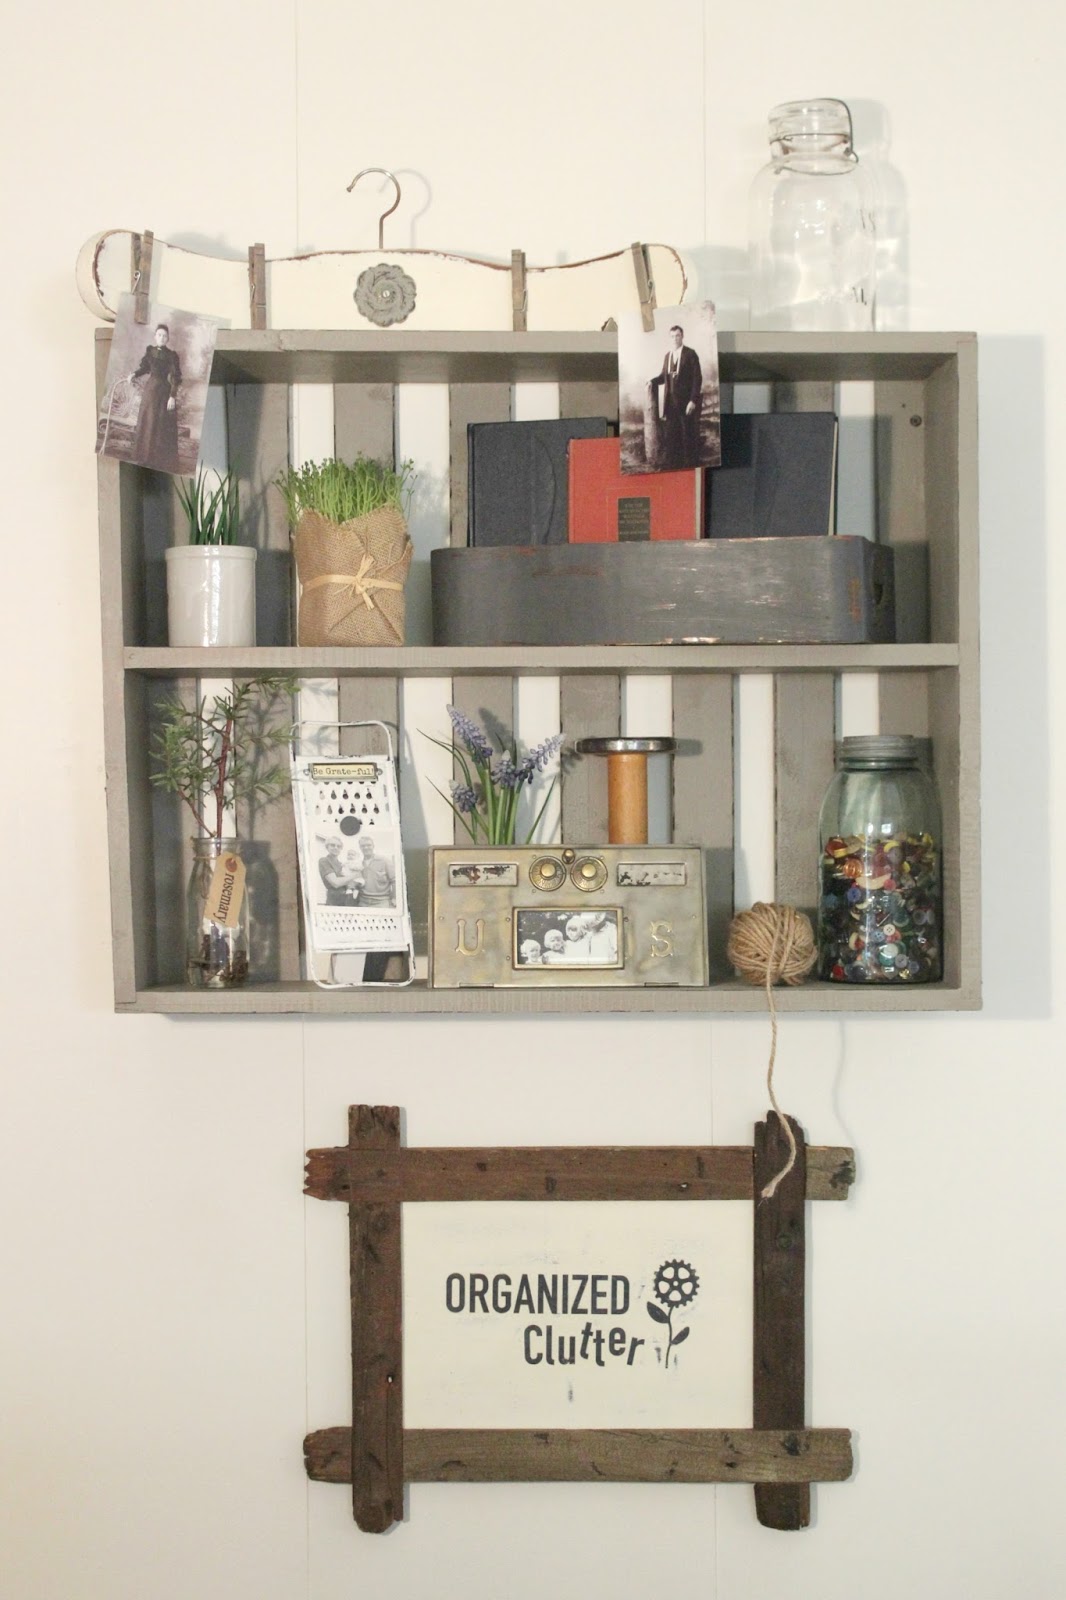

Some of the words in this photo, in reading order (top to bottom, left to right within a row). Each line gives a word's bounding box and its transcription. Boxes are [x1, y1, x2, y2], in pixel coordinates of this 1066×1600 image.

[313, 767, 323, 775] Be
[213, 873, 235, 923] rosemary
[455, 919, 485, 957] U
[650, 920, 673, 957] S
[445, 1273, 630, 1315] ORGANIZED
[523, 1321, 645, 1367] Clutter
